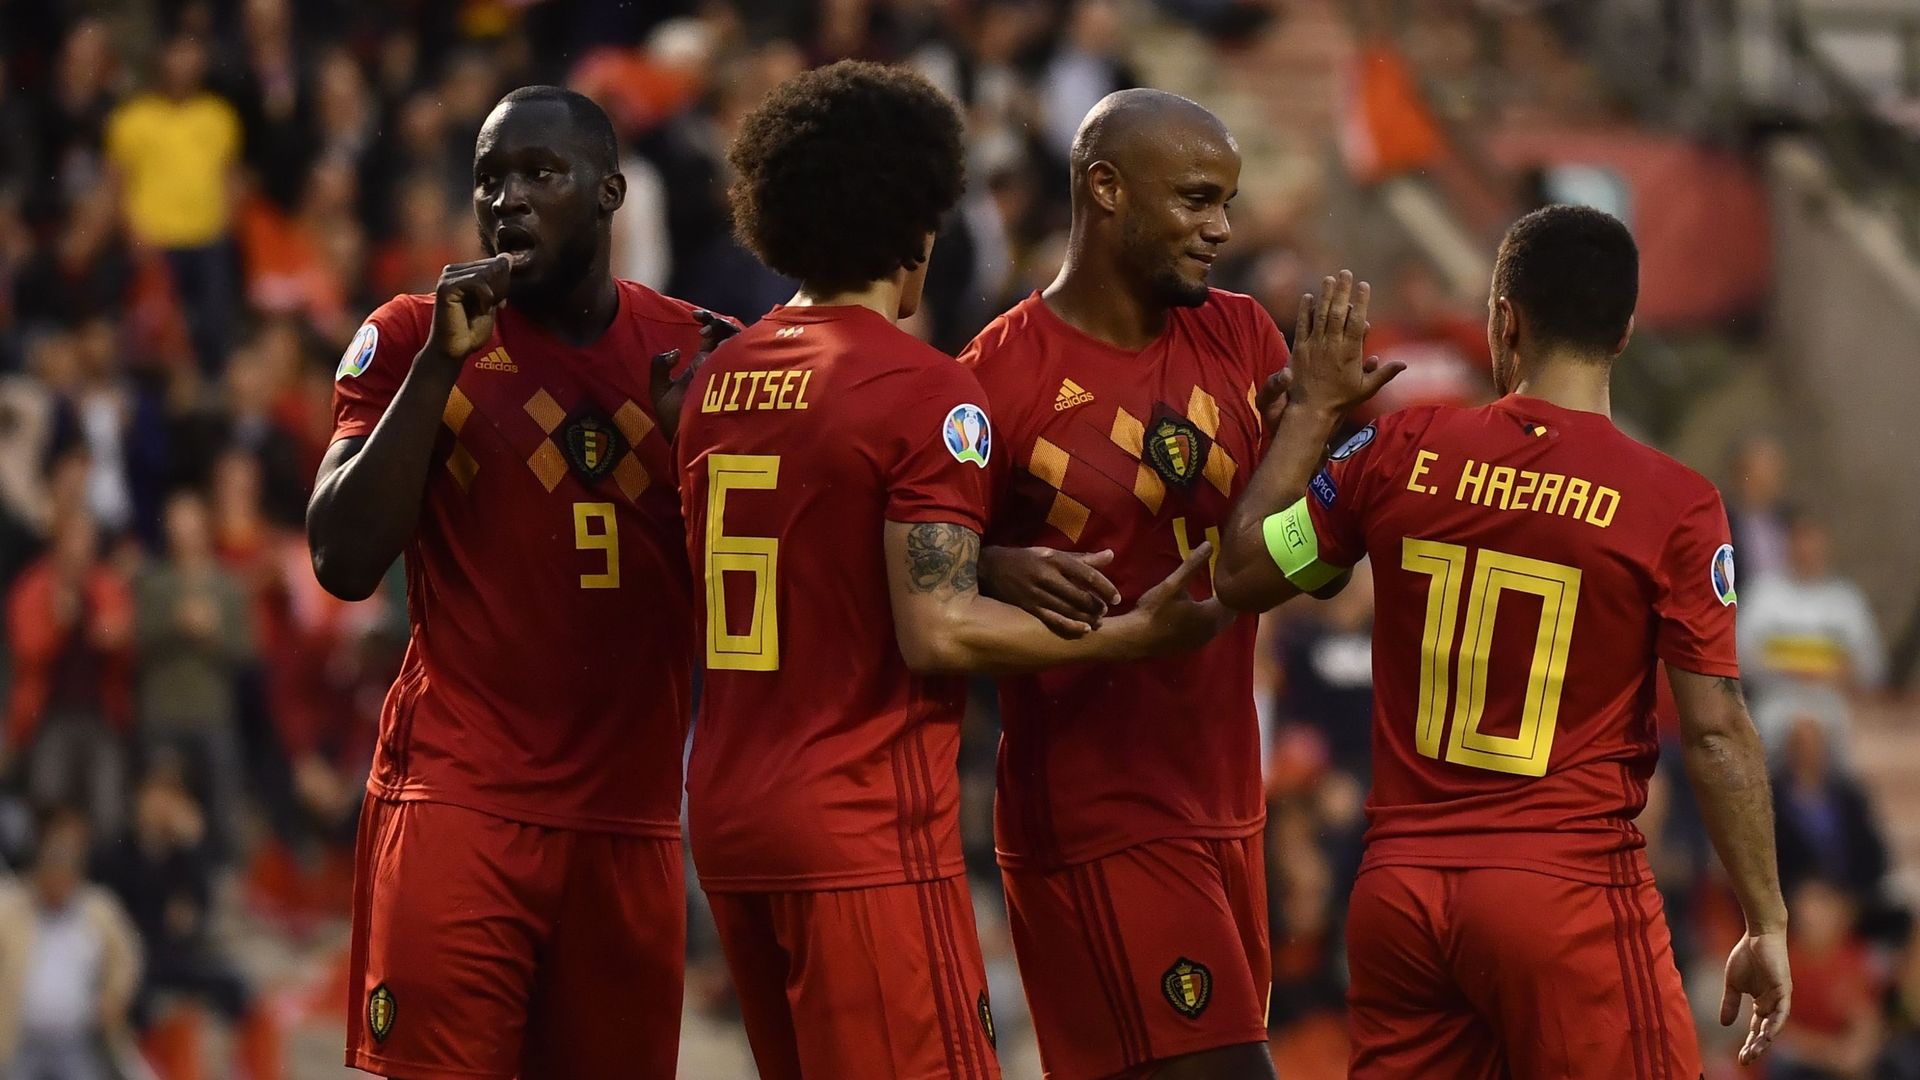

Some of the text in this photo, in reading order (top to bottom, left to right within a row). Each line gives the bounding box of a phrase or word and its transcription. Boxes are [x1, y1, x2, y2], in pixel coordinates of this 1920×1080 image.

[474, 361, 519, 374] adidas
[701, 370, 812, 413] WITSEL
[1054, 392, 1095, 412] adidas
[1407, 449, 1621, 529] E. HAZARD
[573, 503, 620, 589] 9
[705, 453, 781, 672] 6
[1401, 536, 1583, 778] 10
